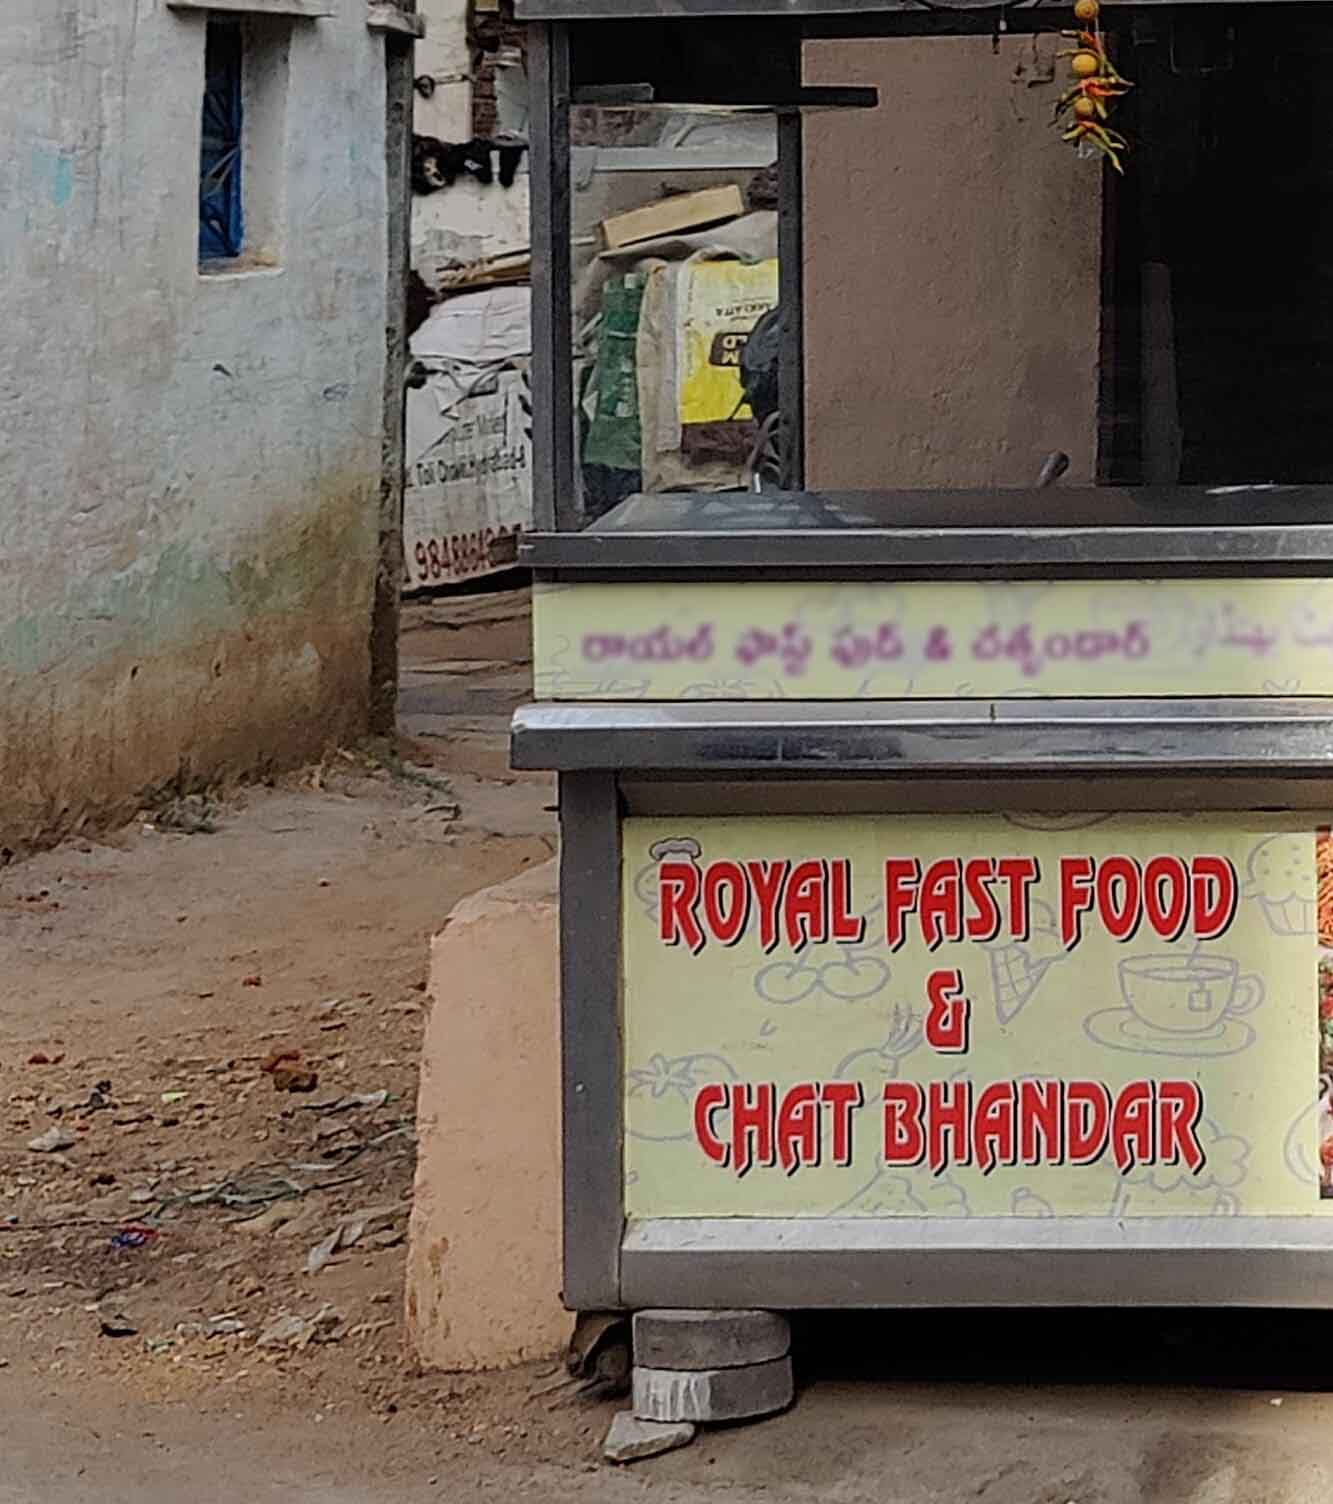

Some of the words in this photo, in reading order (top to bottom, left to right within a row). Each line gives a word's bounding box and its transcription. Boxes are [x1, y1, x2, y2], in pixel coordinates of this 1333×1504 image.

[658, 855, 866, 953] ROYAL
[885, 856, 1042, 949] FAST
[1060, 856, 1238, 949] FOOD
[924, 969, 970, 1054] &
[693, 1080, 865, 1175] CHAT
[882, 1080, 1207, 1175] BHANDAR
